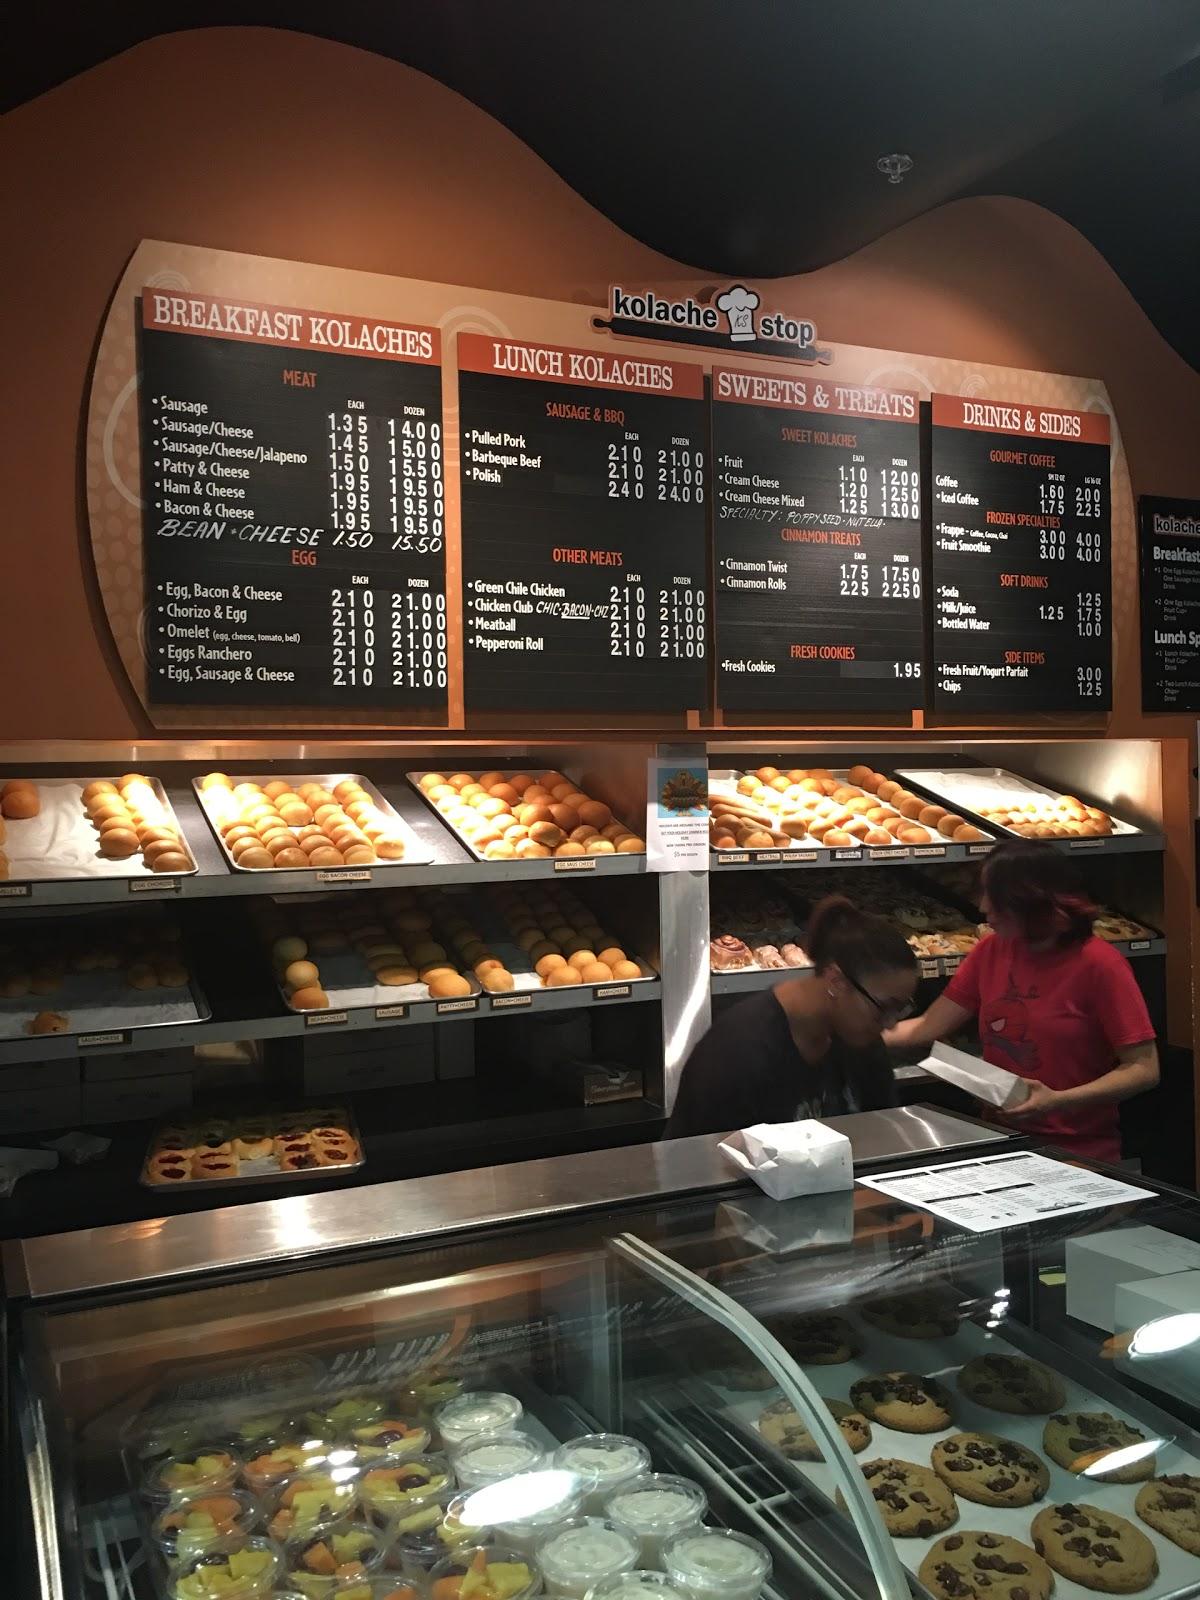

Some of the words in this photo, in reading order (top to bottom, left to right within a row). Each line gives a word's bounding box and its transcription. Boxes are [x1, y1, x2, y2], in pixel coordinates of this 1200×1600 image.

[614, 288, 717, 327] kolache
[761, 315, 813, 345] stop
[154, 295, 301, 341] BREAKFAST
[310, 317, 432, 358] KOLACHES
[493, 344, 563, 376] LUNCH
[569, 354, 673, 390] KOLACHES
[283, 370, 316, 388] MEAT
[718, 372, 806, 406] SWEETS
[813, 385, 829, 408] &
[835, 388, 915, 418] TREATS
[161, 396, 208, 416] Sausage
[348, 400, 364, 409] EACH
[404, 406, 425, 416] DOZEN
[546, 402, 590, 421] SAUSAGE
[593, 408, 601, 421] &
[604, 409, 624, 426] BBQ
[162, 417, 253, 438] Sausage/Cheese
[963, 402, 1020, 430] DRINKS
[1025, 411, 1035, 432] &
[1040, 412, 1080, 437] SIDES
[472, 430, 501, 446] Pulled
[504, 434, 525, 448] Pork
[625, 432, 639, 440] EACH
[672, 437, 689, 446] DOZEN
[782, 428, 812, 442] SWEET
[815, 431, 856, 447] KOLACHES
[162, 437, 307, 465] Sausage/Cheese/Jalapeno
[472, 449, 517, 467] Barbeque
[520, 454, 542, 469] Beef
[990, 450, 1027, 464] GOURMET
[1029, 454, 1055, 468] COFFEE
[163, 458, 195, 477] Patty
[198, 461, 207, 475] &
[210, 463, 249, 478] Cheese
[724, 456, 743, 469] Fruit
[473, 468, 501, 483] Polish
[725, 473, 750, 486] Cream
[752, 475, 779, 489] Cheese
[936, 475, 958, 488] Coffee
[163, 479, 190, 494] Ham
[193, 481, 202, 495] &
[206, 482, 245, 498] Cheese
[725, 490, 750, 503] Cream
[753, 492, 779, 506] Cheese
[782, 494, 805, 507] Mixed
[941, 492, 955, 504] Iced
[957, 494, 979, 505] Coffee
[164, 500, 199, 515] Bacon
[203, 502, 212, 516] &
[215, 504, 254, 519] Cheese
[987, 512, 1016, 525] FROZEN
[1018, 515, 1060, 528] SPECIALTIES
[157, 519, 226, 539] BEAN
[239, 524, 324, 545] CHEESE
[333, 531, 373, 547] 1.50
[392, 536, 442, 553] 15.50
[781, 529, 828, 544] CINNAMON
[830, 532, 861, 546] TREATS
[941, 523, 964, 537] Frappe
[941, 539, 957, 551] Fruit
[959, 540, 991, 553] Smoothie
[1154, 546, 1200, 562] Breakfast
[292, 550, 316, 565] EGG
[553, 548, 587, 564] OTHER
[590, 551, 622, 566] MEATS
[726, 558, 766, 572] Cinnamon
[768, 560, 787, 573] Twist
[352, 576, 368, 584] EACH
[408, 579, 429, 588] DOZEN
[627, 574, 640, 582] EACH
[674, 577, 691, 585] DOZEN
[727, 577, 766, 590] Cinnamon
[768, 578, 786, 590] Rolls
[1001, 574, 1019, 587] SOFT
[1021, 575, 1048, 588] DRINKS
[166, 582, 191, 599] Egg,
[194, 583, 229, 598] Bacon
[232, 585, 241, 599] &
[244, 586, 282, 601] Cheese
[475, 580, 503, 595] Green
[506, 582, 528, 596] Chile
[530, 583, 565, 597] Chicken
[942, 586, 959, 597] Soda
[167, 603, 210, 618] Chorizo
[214, 605, 223, 619] &
[226, 606, 247, 623] Egg
[475, 599, 511, 612] Chicken
[514, 600, 533, 613] Club
[942, 602, 976, 615] Milk/Juice
[168, 624, 210, 639] Omelet
[476, 617, 516, 631] Meatball
[942, 618, 968, 629] Bottled
[970, 619, 990, 630] Water
[476, 637, 523, 651] Pepperoni
[526, 638, 543, 650] Roll
[1155, 630, 1186, 644] Lunch
[168, 645, 195, 662] Eggs
[198, 645, 252, 660] Ranchero
[791, 645, 817, 658] FRESH
[819, 646, 855, 660] COOKIES
[1005, 652, 1021, 663] SIDE
[1023, 652, 1044, 664] ITEMS
[168, 665, 193, 682] Egg,
[196, 666, 242, 683] Sausage
[245, 667, 253, 681] &
[257, 667, 295, 681] Cheese
[725, 660, 745, 672] Fresh
[747, 661, 775, 673] Cookies
[894, 662, 920, 678] 1.95
[943, 664, 961, 675] Fresh
[963, 665, 1004, 679] Fruit/Yogurt
[1006, 667, 1028, 677] Parfait
[943, 680, 961, 693] Chips
